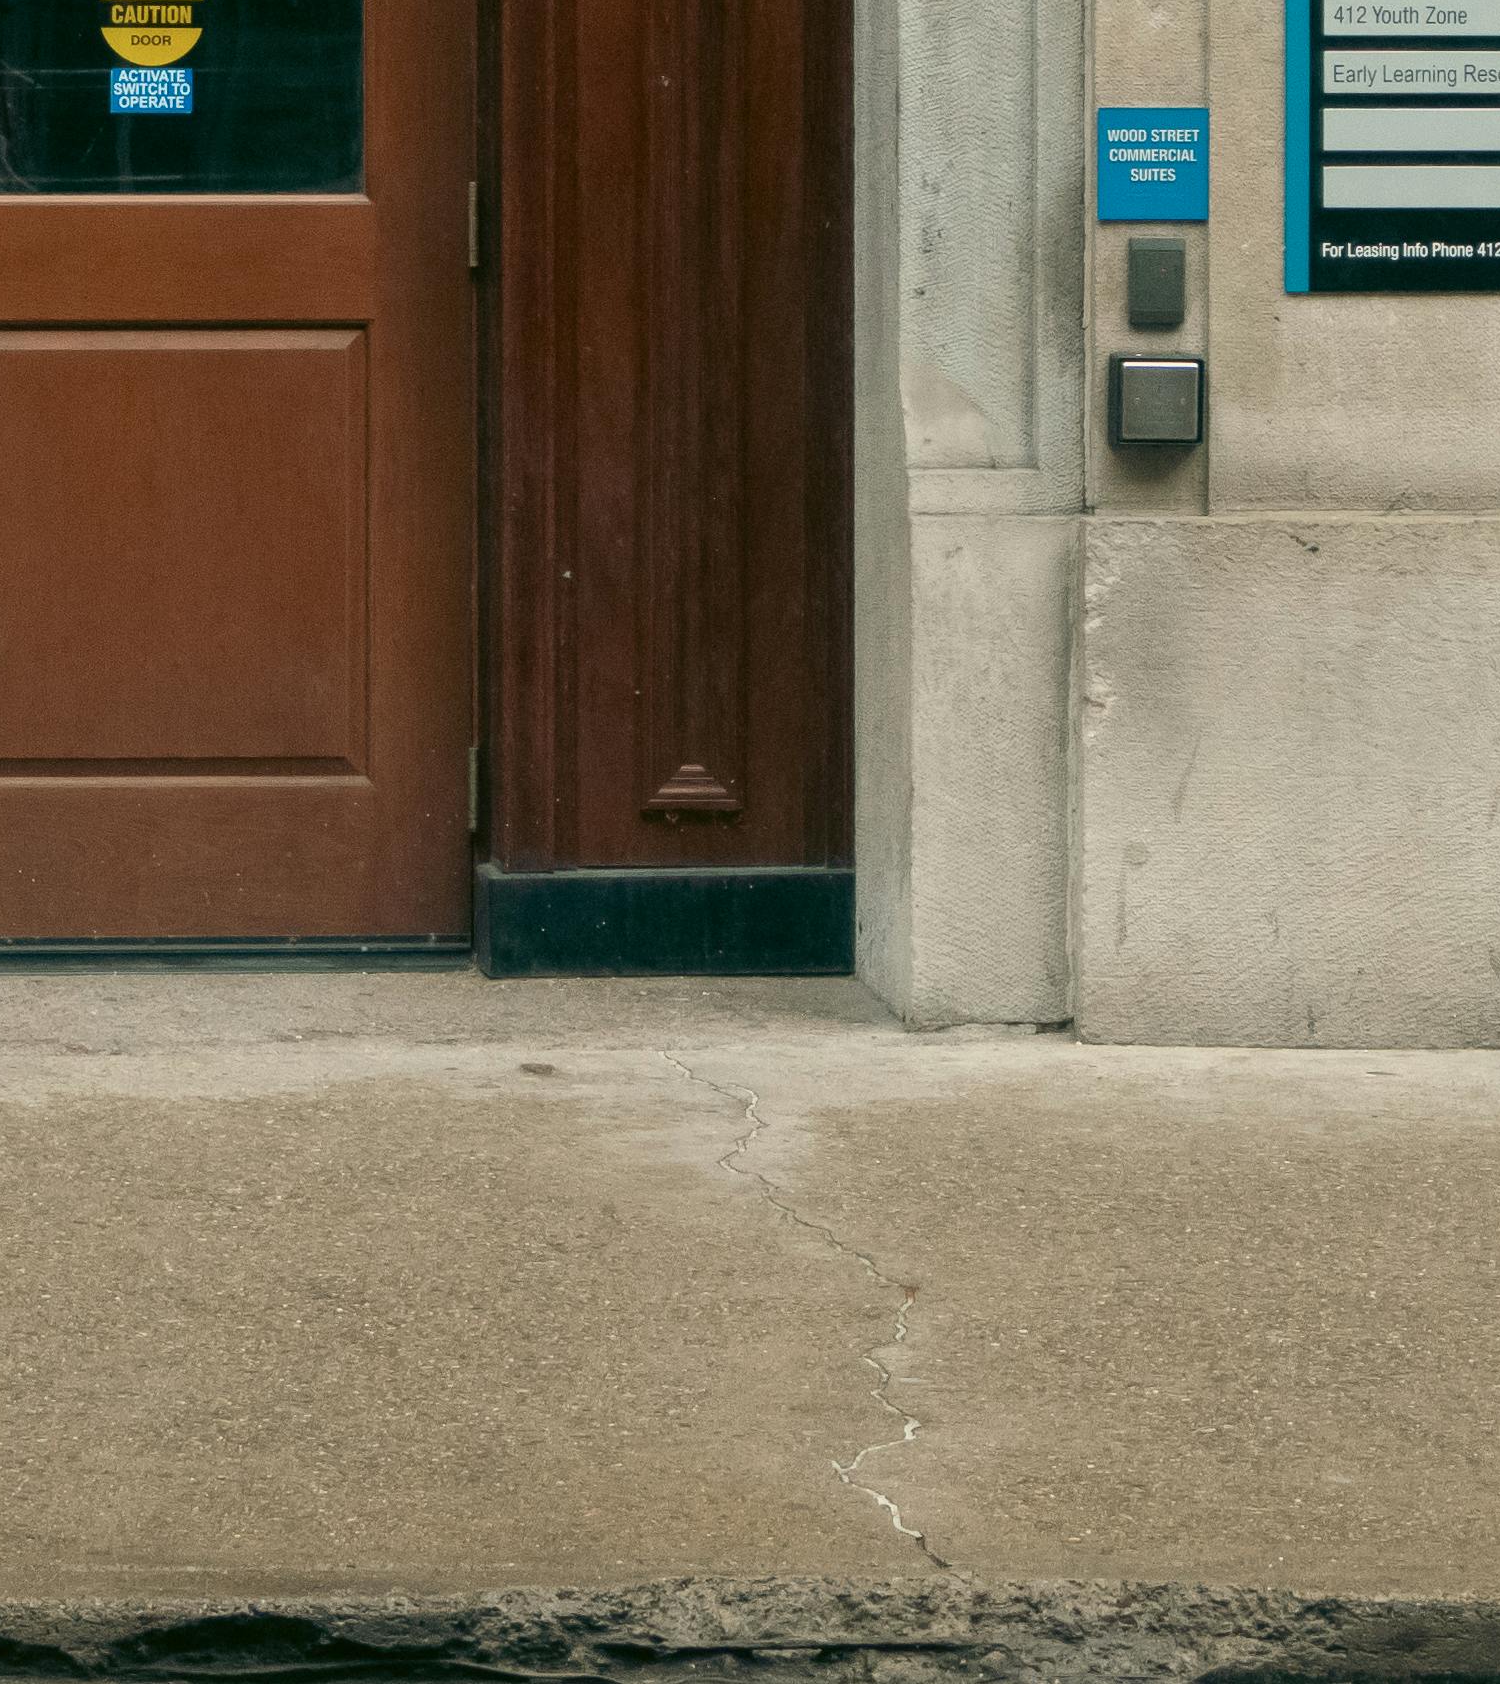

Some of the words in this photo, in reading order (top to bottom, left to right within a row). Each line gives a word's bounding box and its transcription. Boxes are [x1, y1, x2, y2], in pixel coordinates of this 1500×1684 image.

[111, 5, 192, 24] CAUTION
[1333, 6, 1367, 24] 412
[1372, 6, 1419, 24] Youth
[1425, 6, 1468, 25] Zone
[131, 35, 172, 46] DOOR
[119, 70, 185, 82] ACTIVATE
[1333, 64, 1377, 87] Early
[1382, 64, 1457, 87] Learning
[113, 83, 169, 95] SWITCH
[172, 83, 190, 95] TO
[119, 96, 184, 108] OPERATE
[1107, 129, 1147, 142] WOOD
[1151, 129, 1200, 142] STREET
[1109, 148, 1197, 162] COMMERCIAL
[1130, 168, 1176, 182] SUITES
[1322, 243, 1344, 258] For
[1347, 243, 1399, 260] Leasing
[1403, 243, 1428, 257] Info
[1432, 243, 1473, 257] Phone
